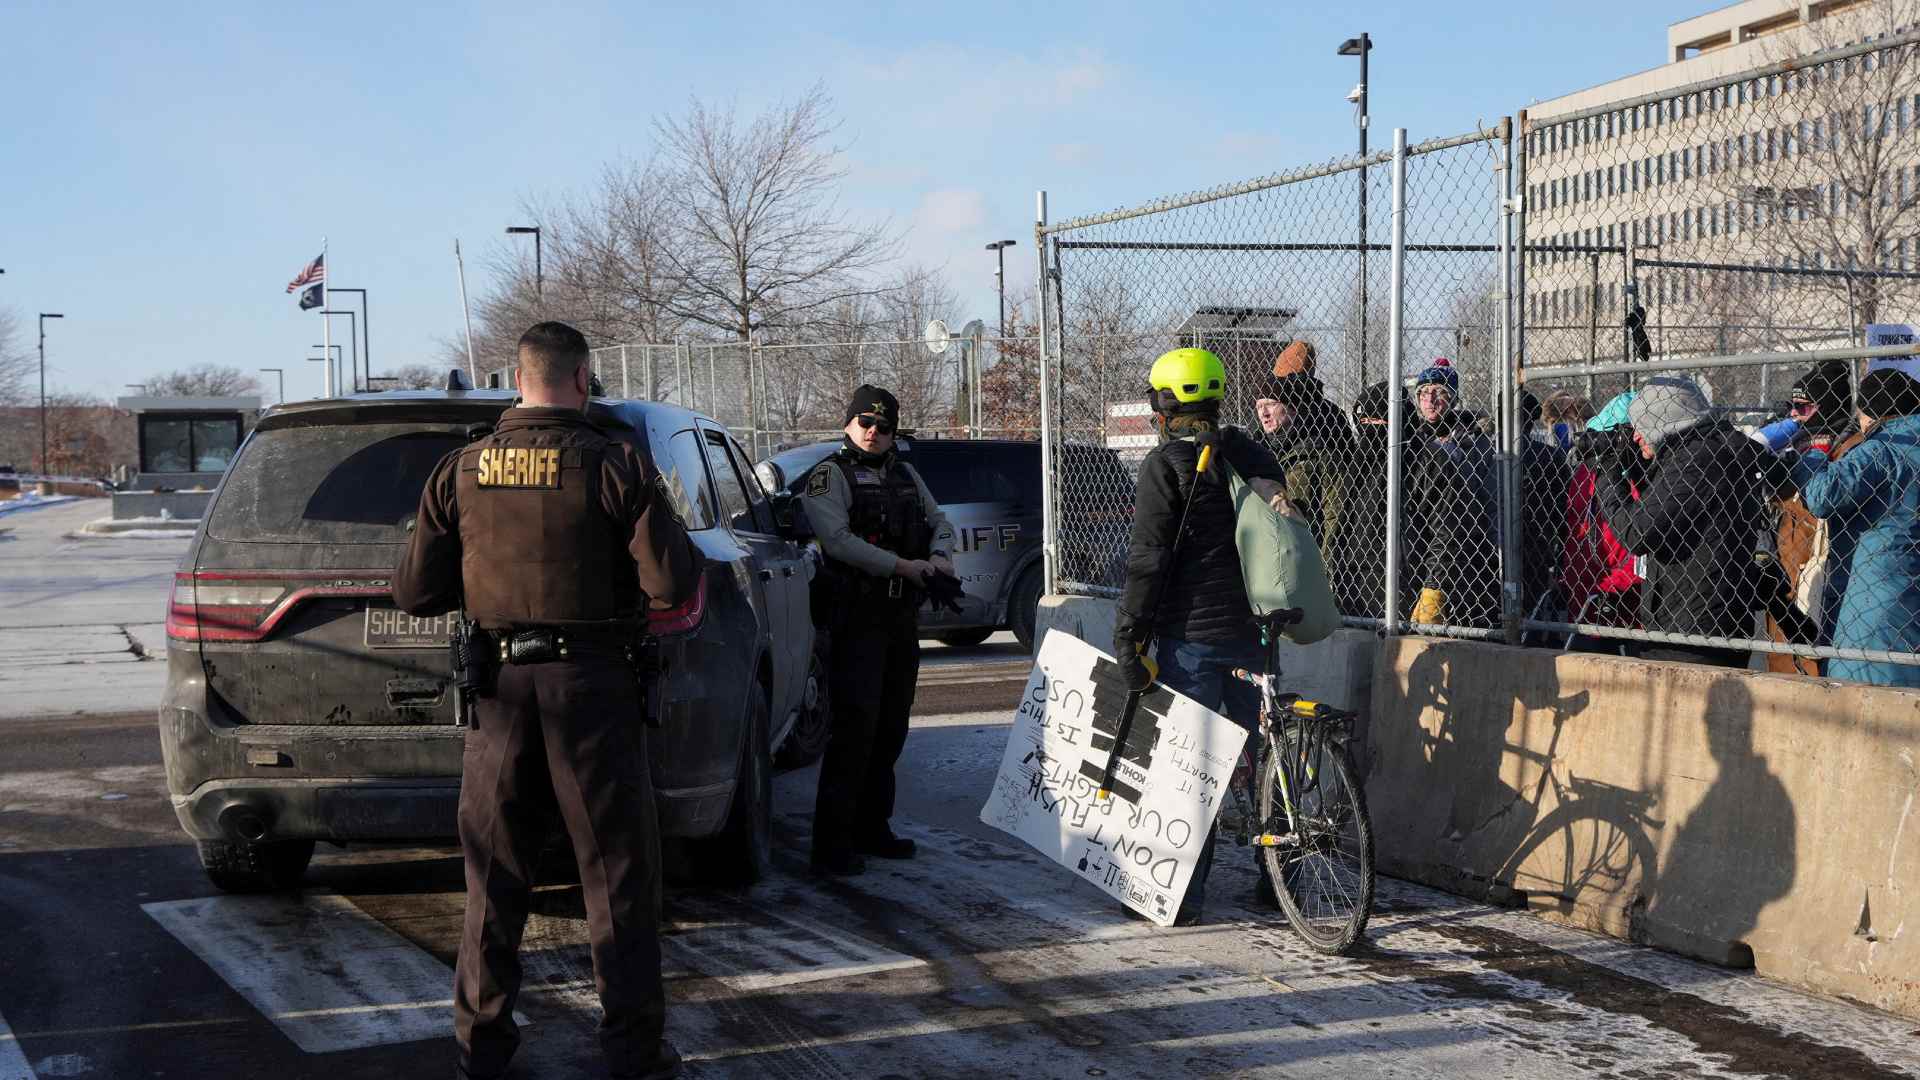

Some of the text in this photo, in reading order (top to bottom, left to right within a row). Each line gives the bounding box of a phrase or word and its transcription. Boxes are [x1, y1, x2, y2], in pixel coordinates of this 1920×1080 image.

[478, 448, 560, 485] SHERIFF
[371, 611, 459, 635] SHERIFF
[1032, 666, 1084, 717] US?
[1020, 700, 1052, 729] THIS
[1171, 750, 1219, 789] WORTH
[1176, 779, 1213, 807] IS IT
[1028, 771, 1179, 890] DON'T FLUSH
[1128, 803, 1191, 848] OUR
